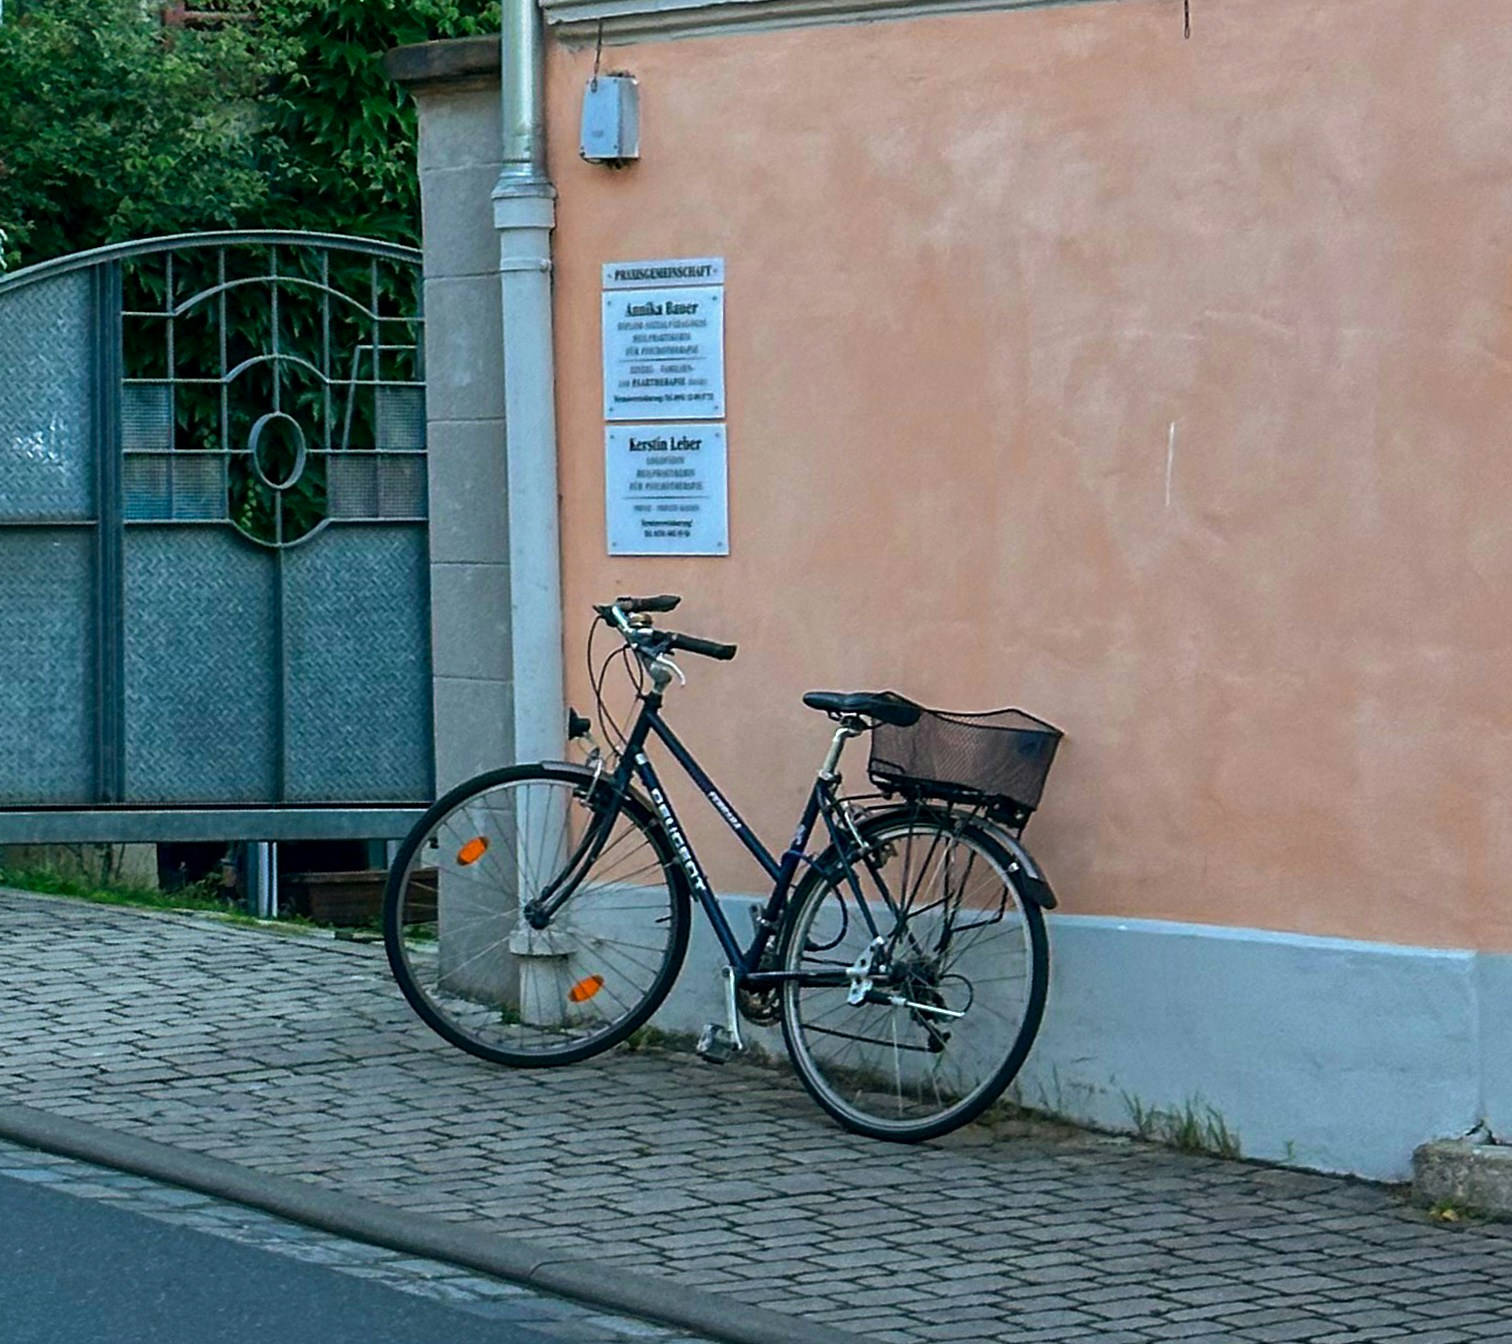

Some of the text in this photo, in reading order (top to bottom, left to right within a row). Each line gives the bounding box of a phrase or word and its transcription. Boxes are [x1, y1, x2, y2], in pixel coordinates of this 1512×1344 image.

[625, 301, 699, 317] Annika Bauer
[629, 437, 668, 451] Kerstin
[651, 787, 707, 891] PEUGEOT
